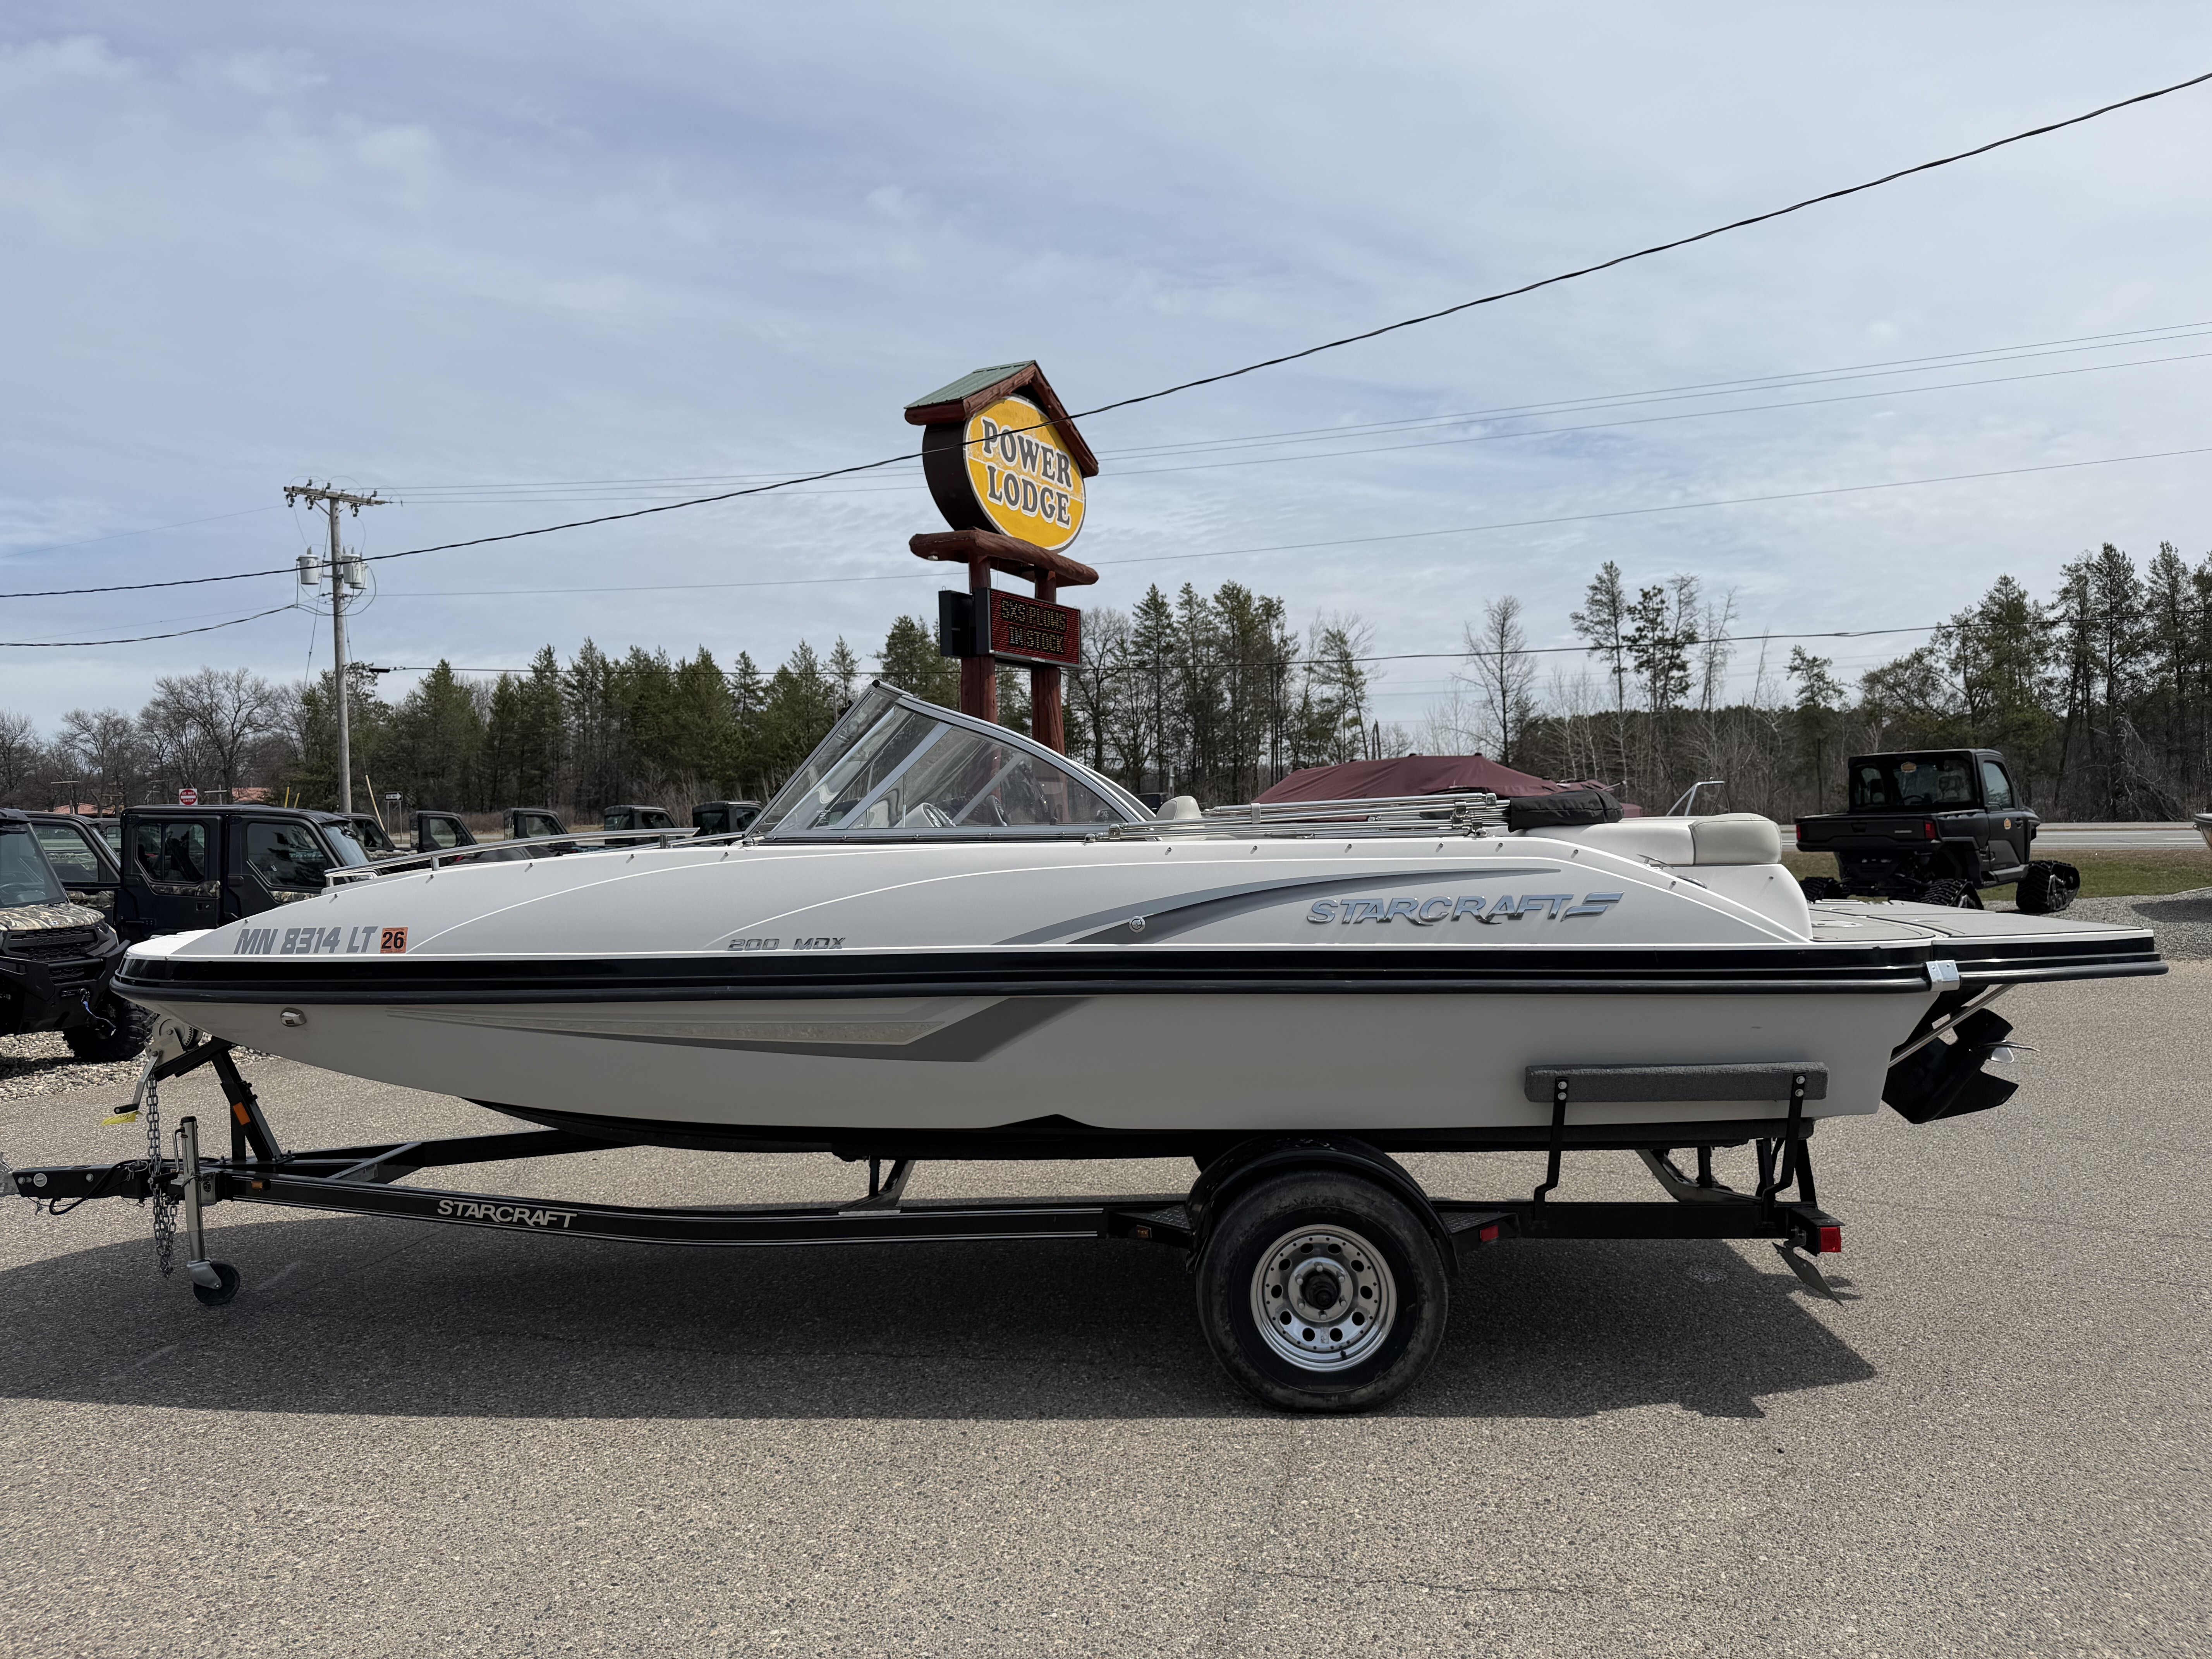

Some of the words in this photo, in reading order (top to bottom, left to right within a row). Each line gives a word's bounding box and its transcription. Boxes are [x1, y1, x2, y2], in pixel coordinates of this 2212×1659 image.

[982, 419, 1072, 488] POWER
[987, 465, 1070, 526] LODGE
[1001, 600, 1025, 622] SXS
[1029, 606, 1066, 630] PLOWS
[1009, 626, 1024, 646] IN
[1026, 630, 1064, 653] STOCK
[1306, 894, 1574, 926] STARCRAFT
[233, 928, 278, 955] MN
[280, 927, 342, 955] 8314
[346, 926, 378, 953] LT
[381, 931, 404, 949] 26
[727, 938, 780, 951] 200
[793, 937, 846, 950] MDX
[437, 1200, 577, 1228] STARCRAFT
